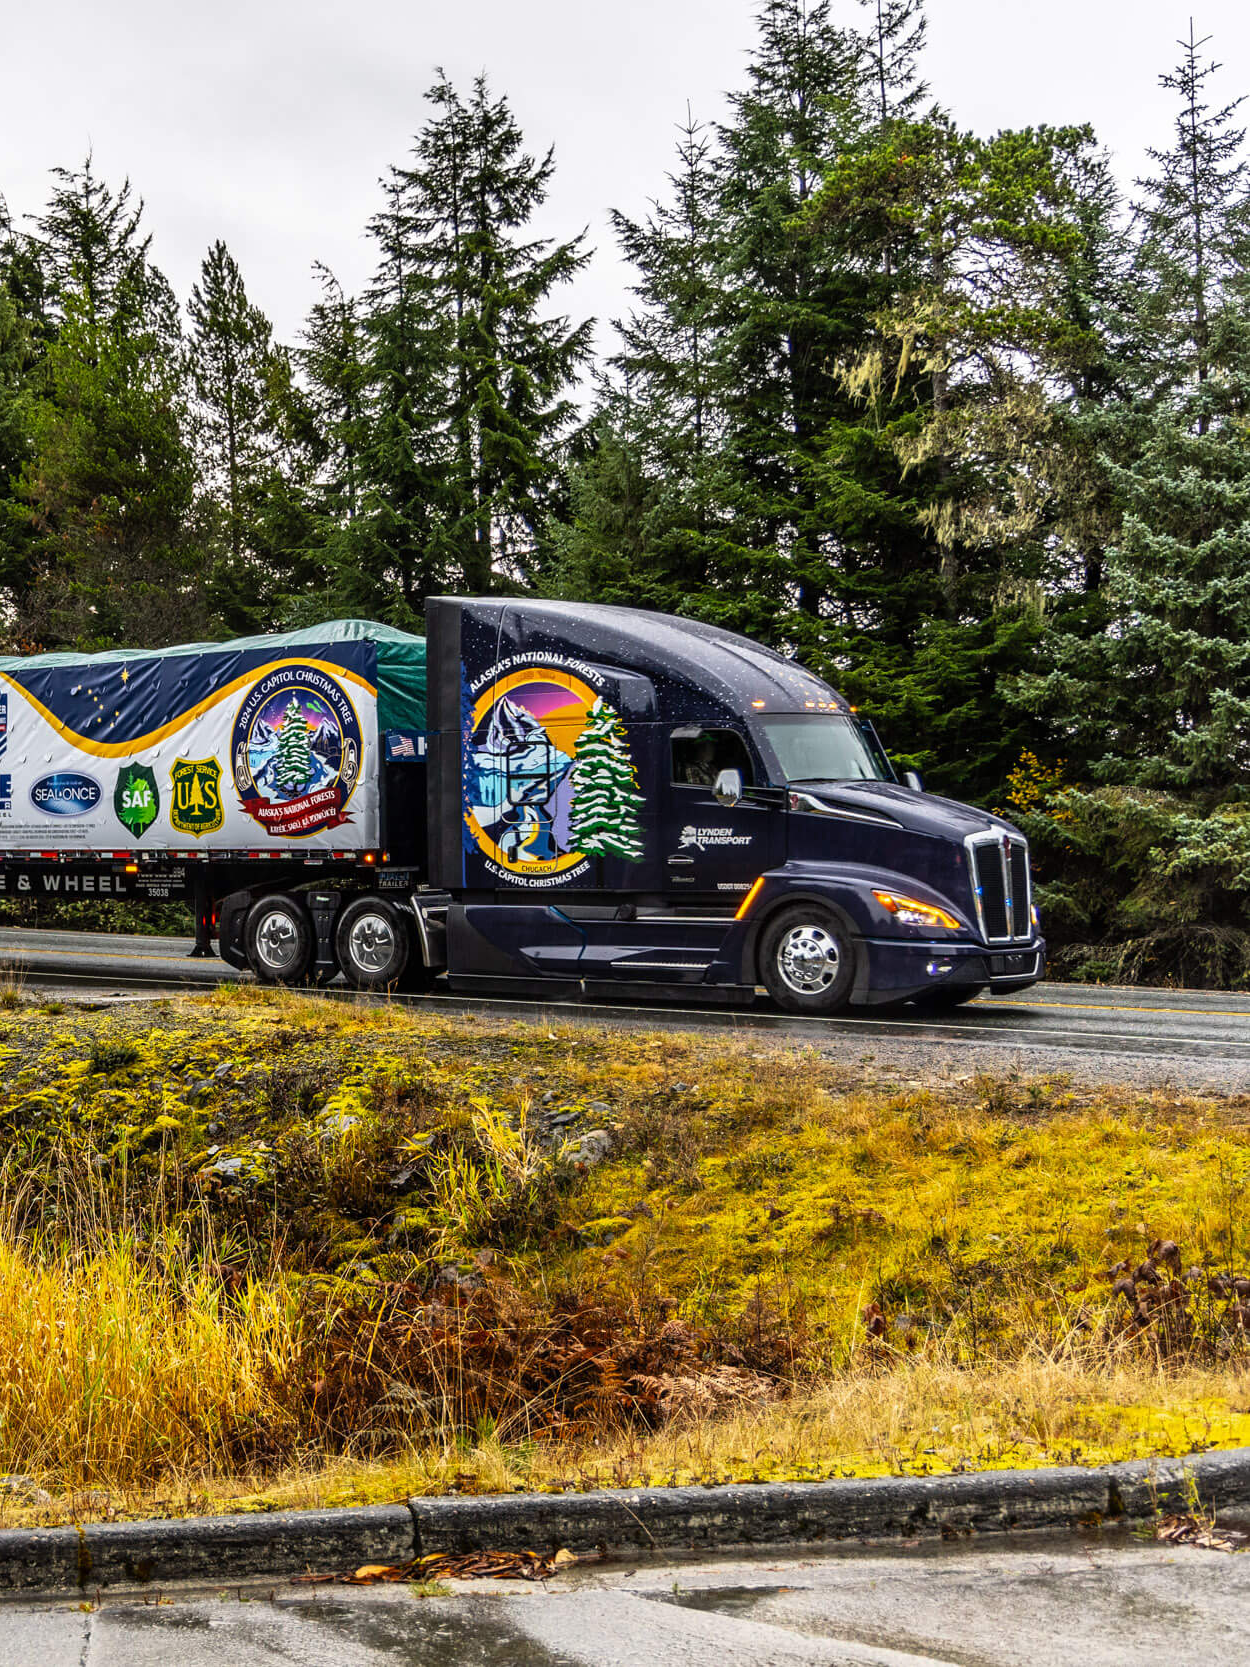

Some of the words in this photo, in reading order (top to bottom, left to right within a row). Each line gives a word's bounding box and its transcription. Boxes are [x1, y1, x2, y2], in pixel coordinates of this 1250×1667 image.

[469, 658, 511, 693] ALASKA'S
[512, 651, 563, 666] NATIONAL
[564, 657, 605, 687] FORESTS
[239, 706, 253, 730] 2024
[249, 693, 263, 709] U.S.
[261, 671, 294, 694] CAPITOL
[295, 671, 341, 702] CHRISTMAS
[337, 698, 354, 725] TREE
[175, 765, 194, 780] FOREST
[196, 765, 218, 780] SERVICE
[122, 790, 151, 808] SAF
[258, 807, 283, 817] ALASKA'S
[283, 799, 311, 815] NATIONAL
[310, 790, 336, 805] FORESTS
[697, 828, 733, 836] LYNDEN
[697, 836, 752, 845] TRANSPORT
[484, 860, 498, 875] U.S.
[498, 870, 529, 887] CAPITOL
[529, 872, 572, 888] CHRISTMAS
[571, 860, 591, 877] TREE
[18, 875, 31, 890] &
[43, 875, 127, 892] WHEEL
[148, 888, 169, 897] 35038
